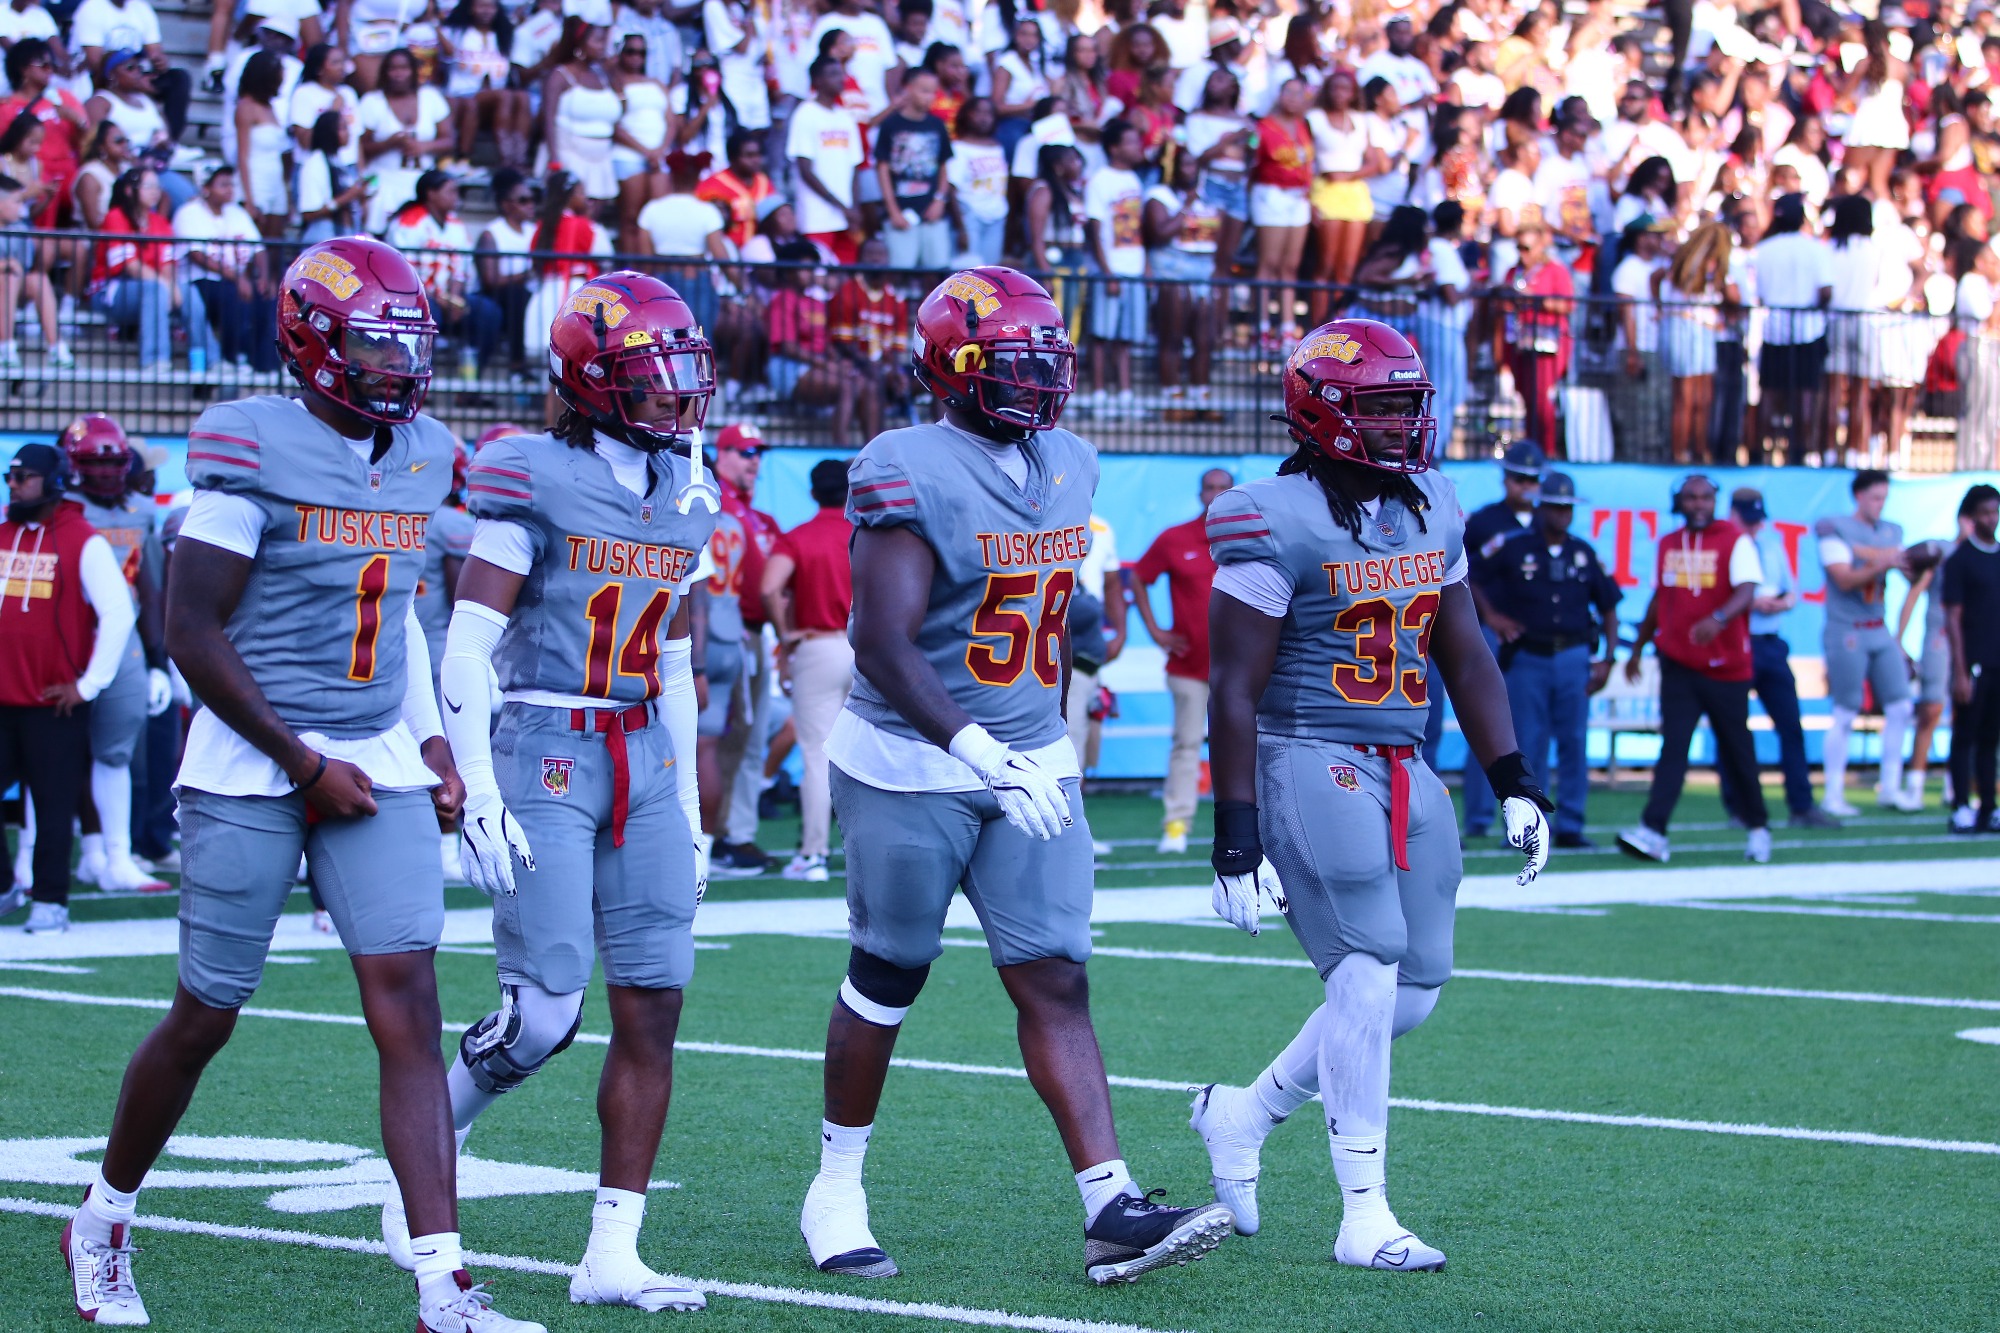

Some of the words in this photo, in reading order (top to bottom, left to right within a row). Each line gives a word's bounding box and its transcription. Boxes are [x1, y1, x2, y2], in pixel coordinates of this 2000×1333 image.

[391, 308, 422, 319] Riddell
[566, 535, 695, 584] TUSKEGEE
[976, 525, 1088, 568] TUSKEGEE
[347, 554, 390, 682] 1
[581, 582, 672, 699] 14
[965, 568, 1075, 688] 58
[1332, 591, 1440, 706] 33
